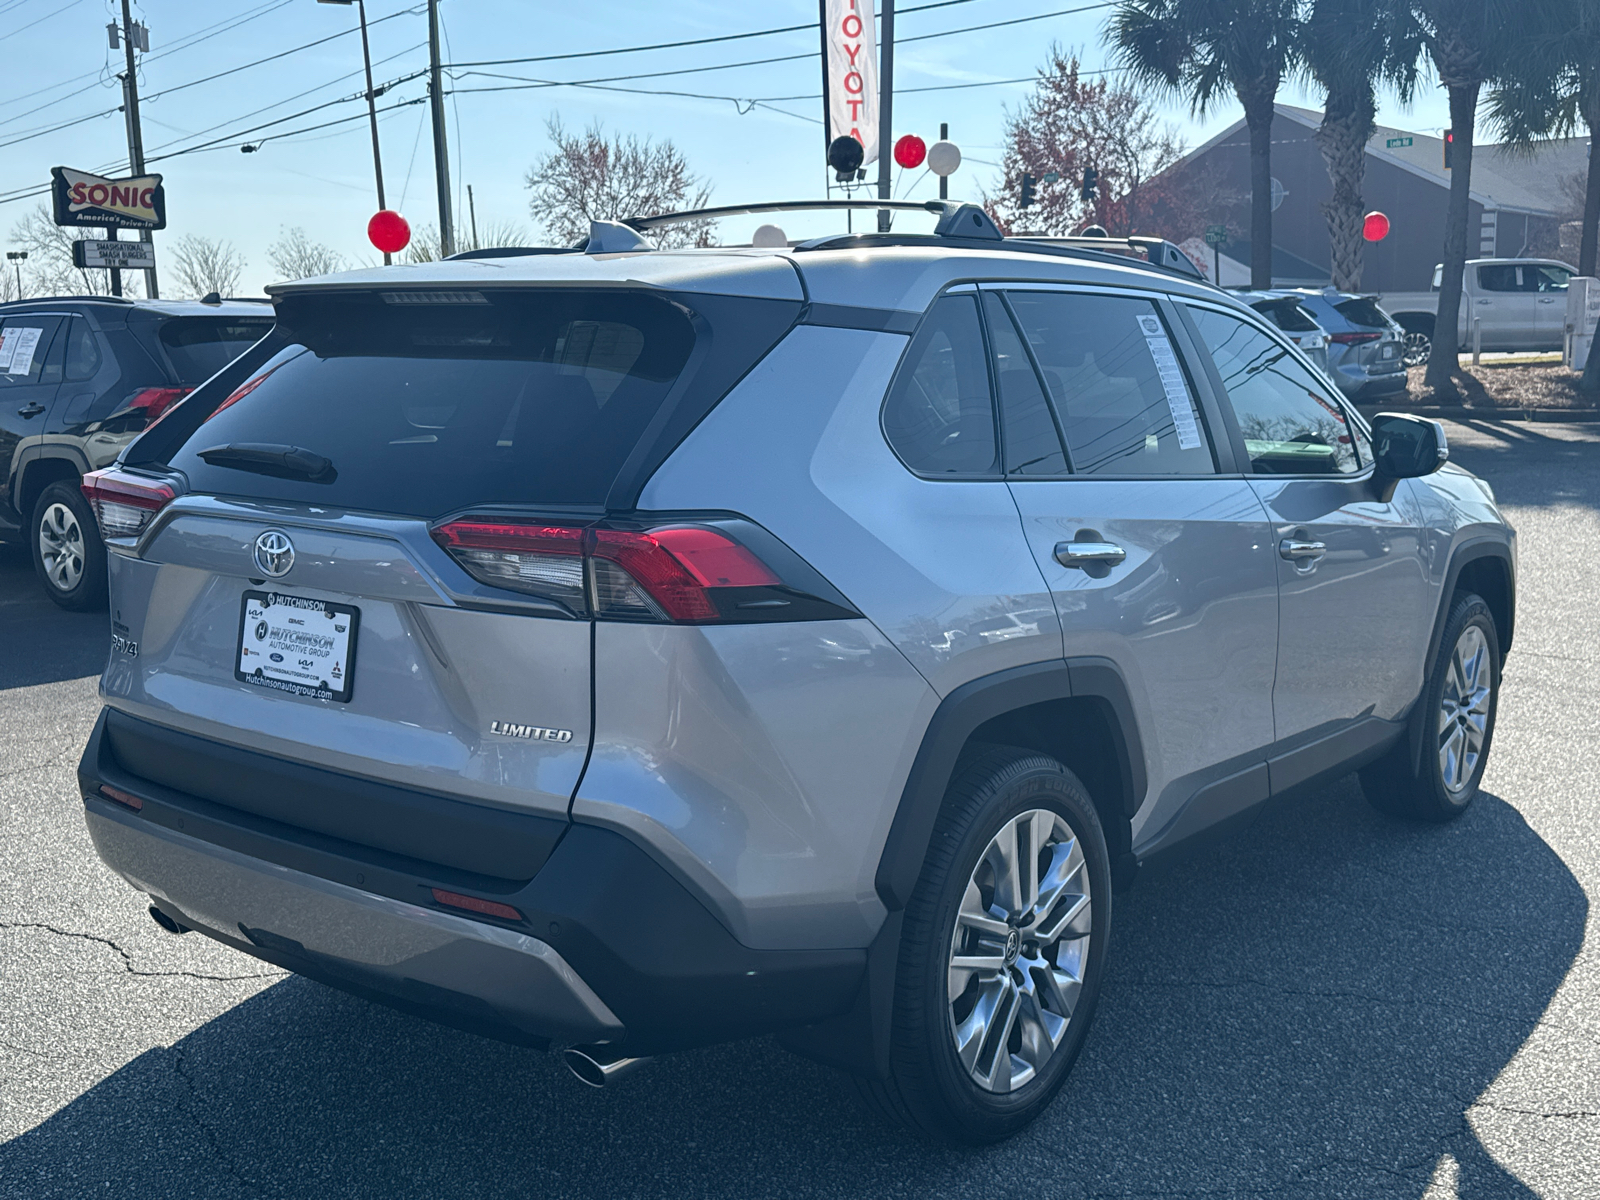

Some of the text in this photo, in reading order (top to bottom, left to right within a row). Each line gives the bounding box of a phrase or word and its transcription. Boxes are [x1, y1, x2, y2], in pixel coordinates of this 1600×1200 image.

[72, 182, 154, 208] SONIC
[76, 213, 120, 222] America's
[99, 250, 147, 259] SMASH BURGERS
[104, 258, 116, 266] TRY
[276, 596, 326, 611] HUTCHINSON
[288, 618, 305, 626] GMC
[268, 627, 335, 649] HUTCHINSON
[268, 641, 331, 658] AUTOMOTIVE GROUP
[245, 674, 333, 699] Hutchinsonautogroup.com
[490, 721, 573, 743] LIMITED
